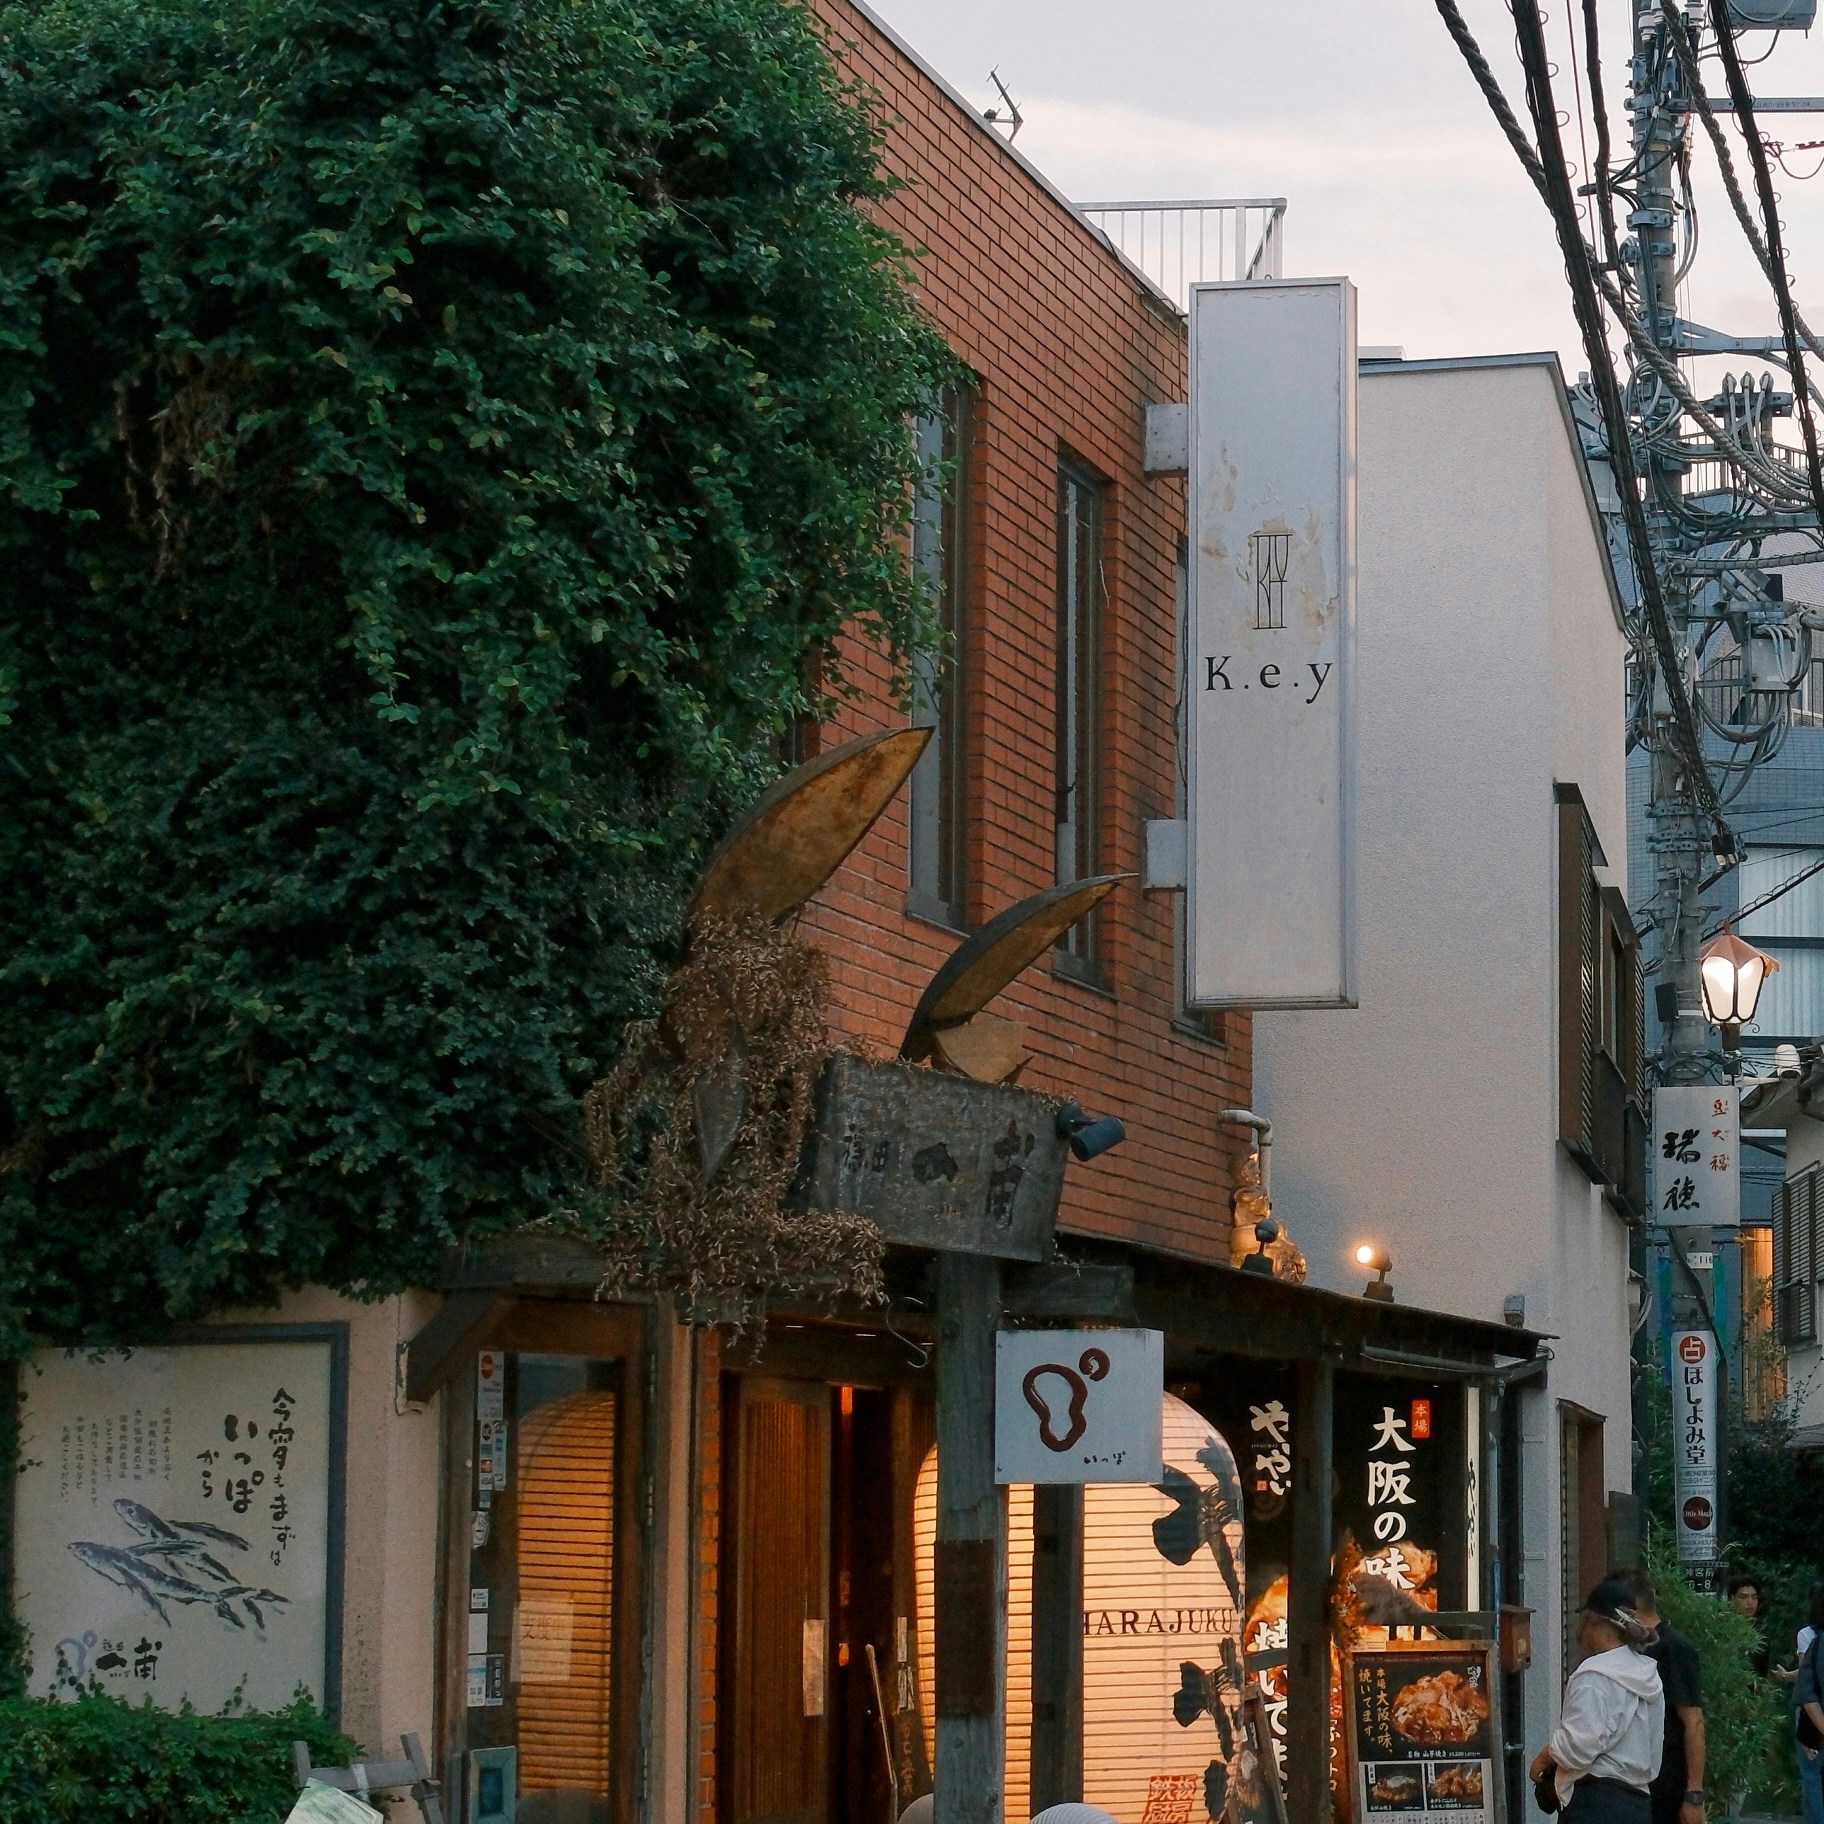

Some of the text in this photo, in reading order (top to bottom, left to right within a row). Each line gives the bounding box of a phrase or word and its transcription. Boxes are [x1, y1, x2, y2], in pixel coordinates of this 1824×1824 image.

[1683, 1337, 1702, 1360] 占
[1412, 1402, 1429, 1434] 本場
[1684, 1366, 1706, 1465] ほしよみ堂
[1368, 1406, 1417, 1590] 大阪の味
